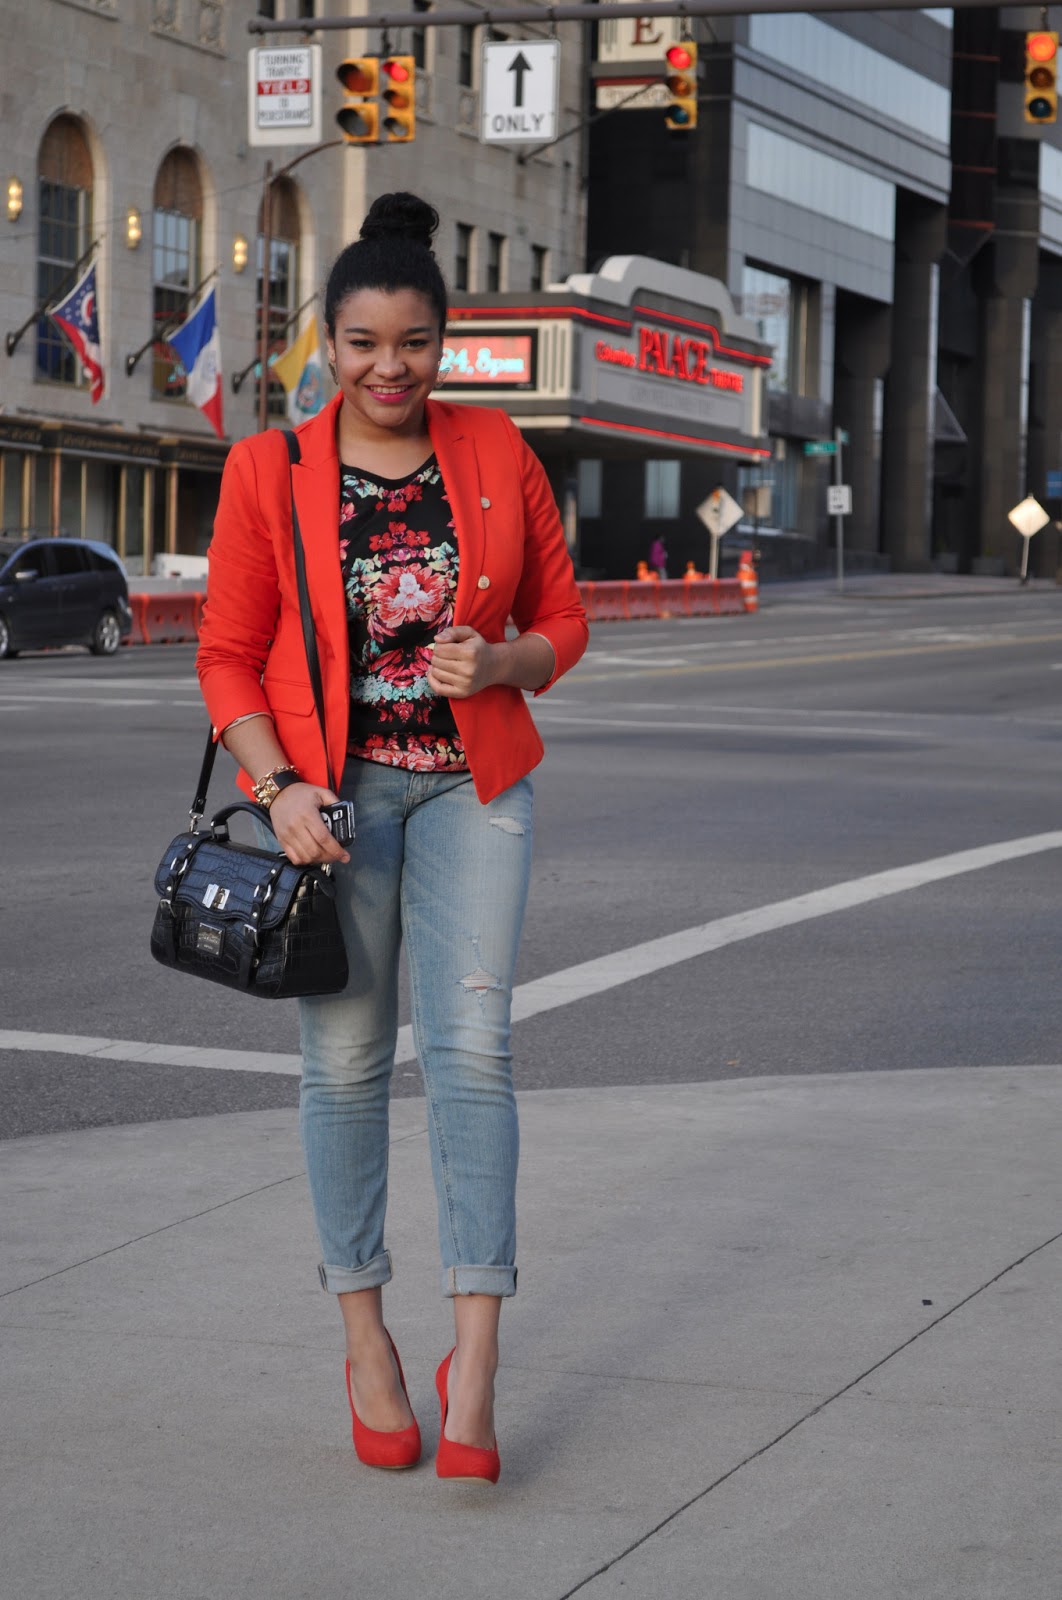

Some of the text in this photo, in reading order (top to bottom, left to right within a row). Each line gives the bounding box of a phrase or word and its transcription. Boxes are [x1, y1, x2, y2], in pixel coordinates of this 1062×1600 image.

[260, 81, 309, 94] YIELD
[492, 114, 545, 133] ONLY
[638, 327, 709, 384] PALACE
